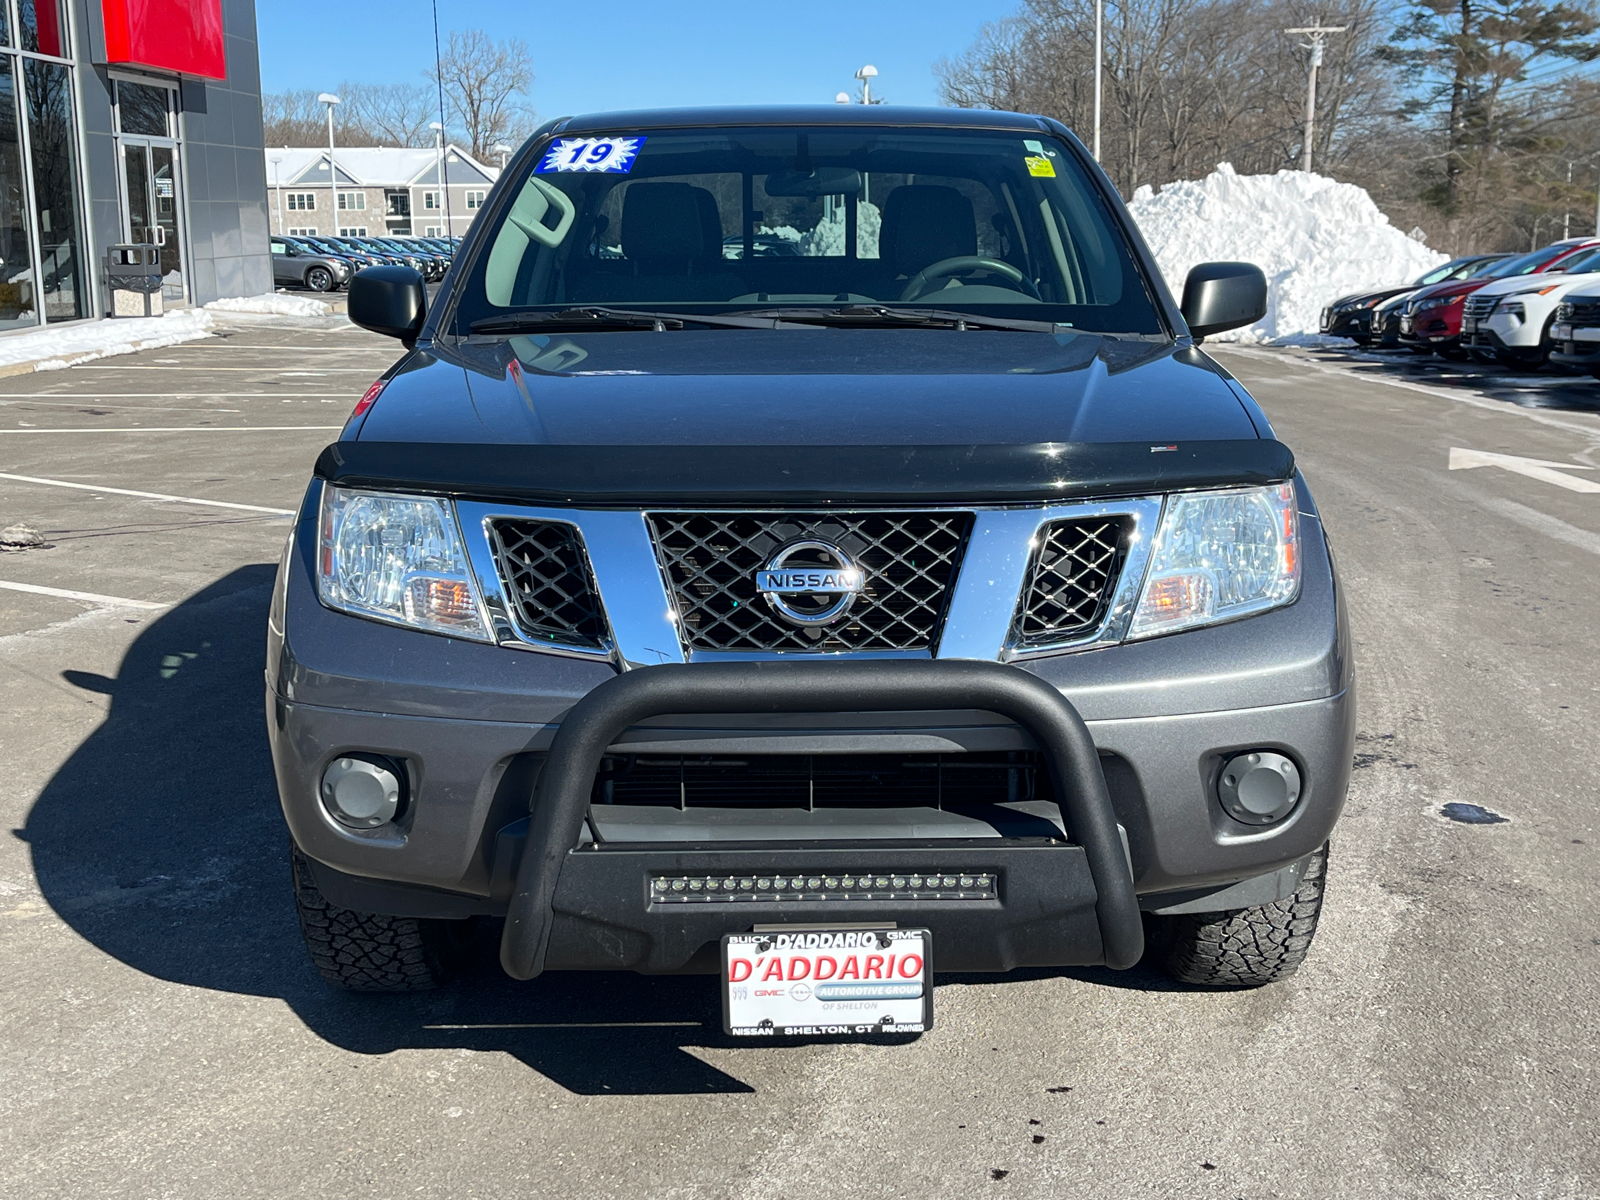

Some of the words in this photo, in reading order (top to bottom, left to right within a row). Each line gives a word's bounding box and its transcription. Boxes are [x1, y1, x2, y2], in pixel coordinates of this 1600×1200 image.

[568, 143, 613, 164] 19
[767, 574, 853, 588] NISSAN
[729, 935, 771, 944] BUICK
[774, 932, 877, 950] D'ADDARIO
[886, 931, 923, 940] GMC
[728, 953, 924, 982] D'ADDARIO
[754, 989, 785, 997] GMC
[820, 986, 884, 996] AUTOMOTIVE
[885, 985, 920, 995] GROUP
[836, 1002, 878, 1010] SHELTON
[732, 1027, 774, 1035] NISSAN
[784, 1025, 852, 1035] SHELTON,
[855, 1024, 874, 1033] CT
[882, 1024, 924, 1033] PRE-OWNED
